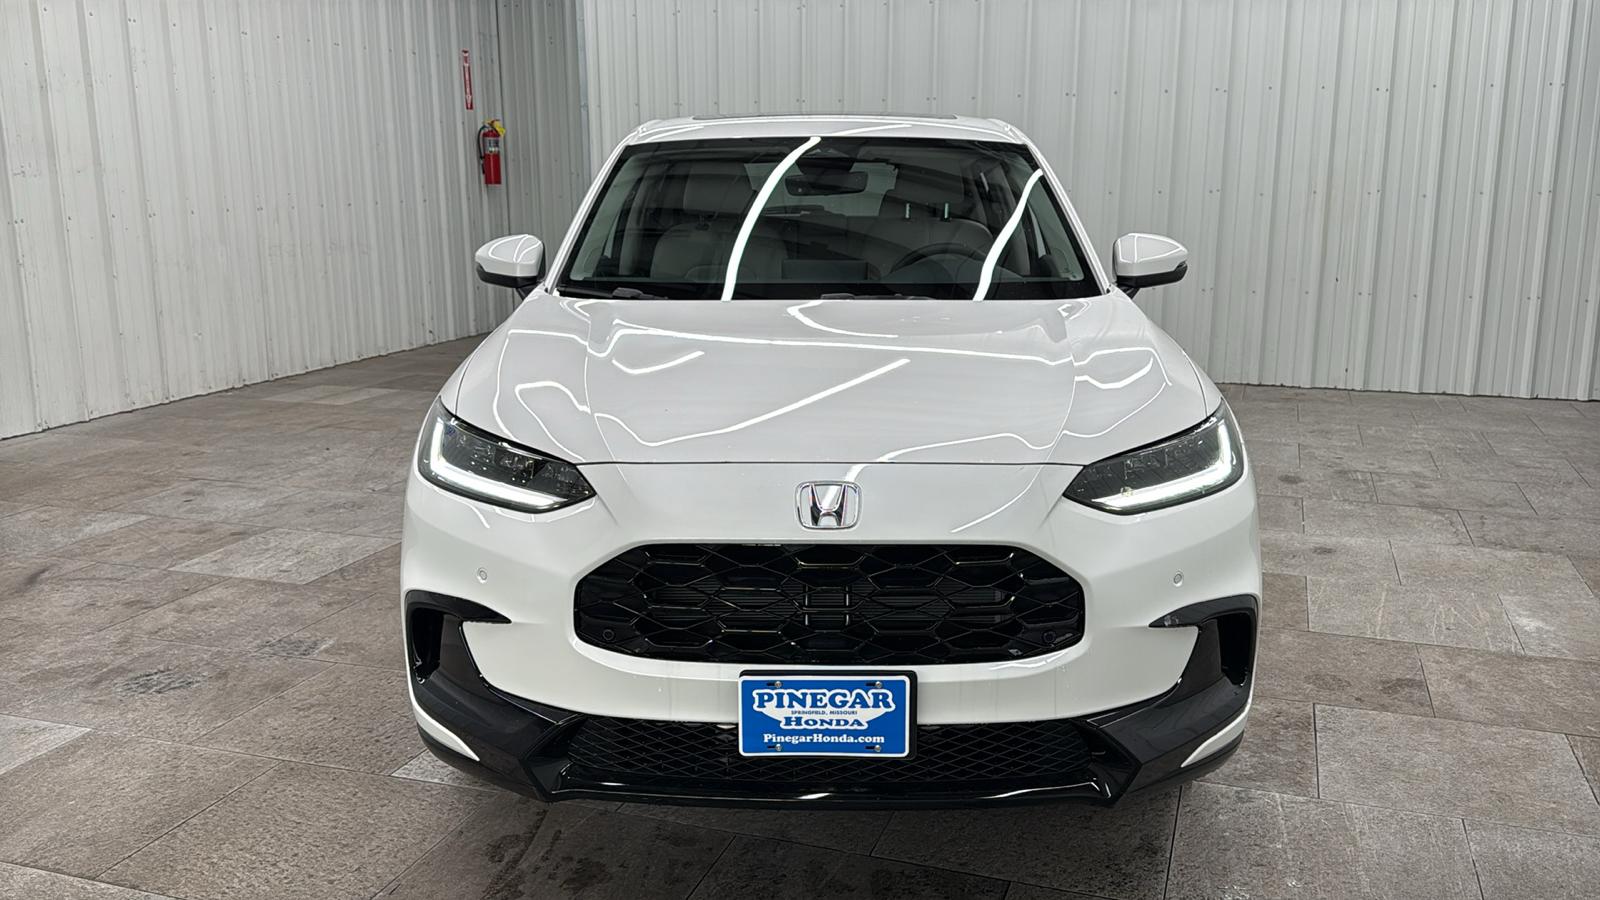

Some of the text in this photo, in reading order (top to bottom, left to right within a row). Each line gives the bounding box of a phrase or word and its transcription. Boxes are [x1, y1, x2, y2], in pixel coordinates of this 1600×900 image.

[755, 692, 893, 709] PINEGAR
[783, 716, 865, 727] HONDA
[763, 733, 885, 745] PinegarHonda.com
